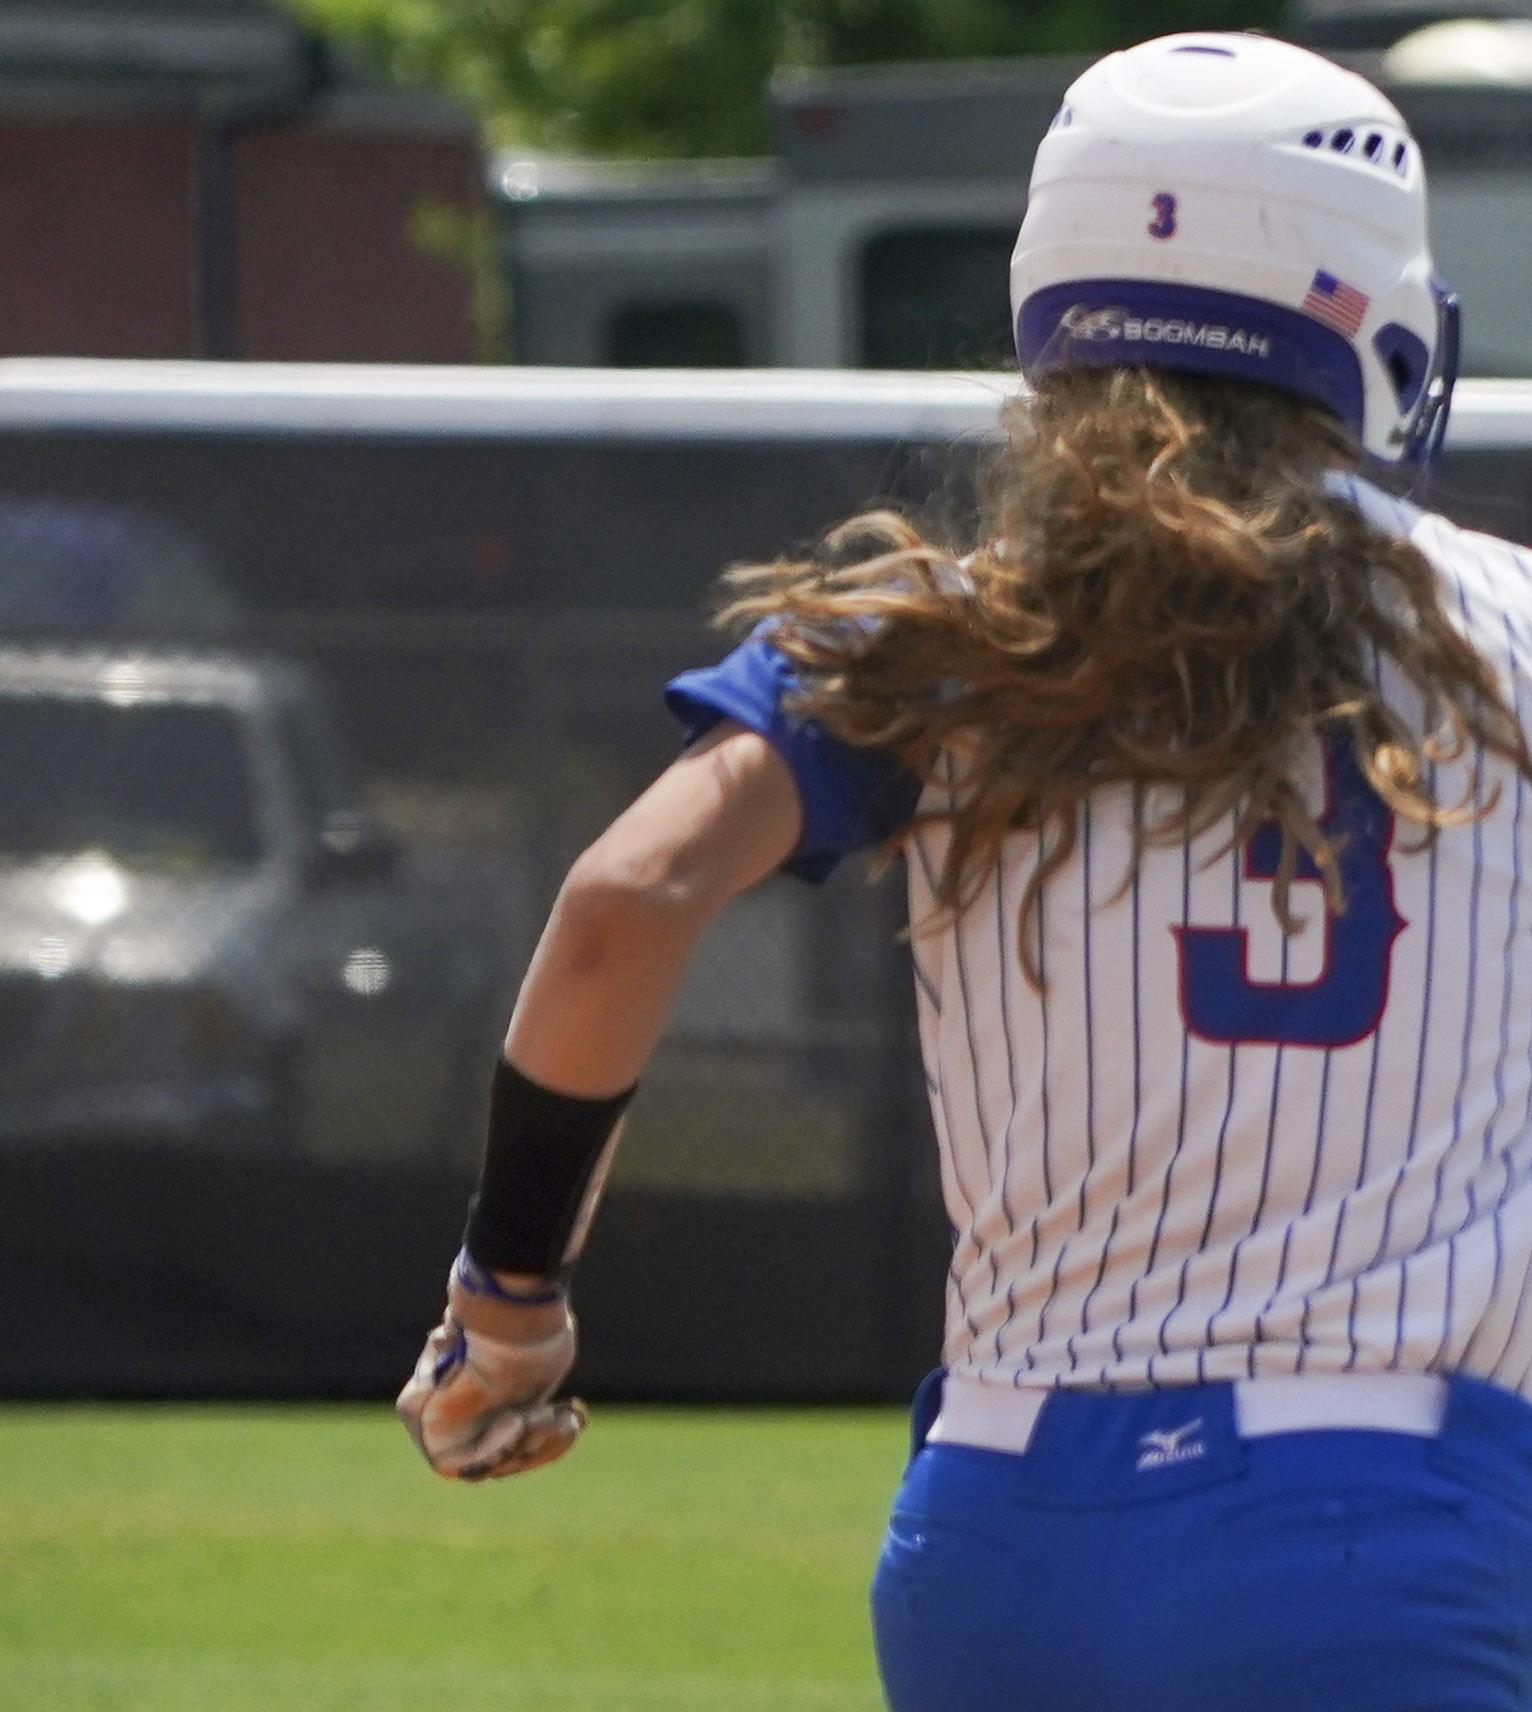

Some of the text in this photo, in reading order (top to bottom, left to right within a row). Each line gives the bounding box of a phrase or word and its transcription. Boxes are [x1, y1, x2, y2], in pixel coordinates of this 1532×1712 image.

[1147, 192, 1176, 239] 3
[1124, 317, 1270, 358] BOOMBAH
[1169, 710, 1409, 1049] 3
